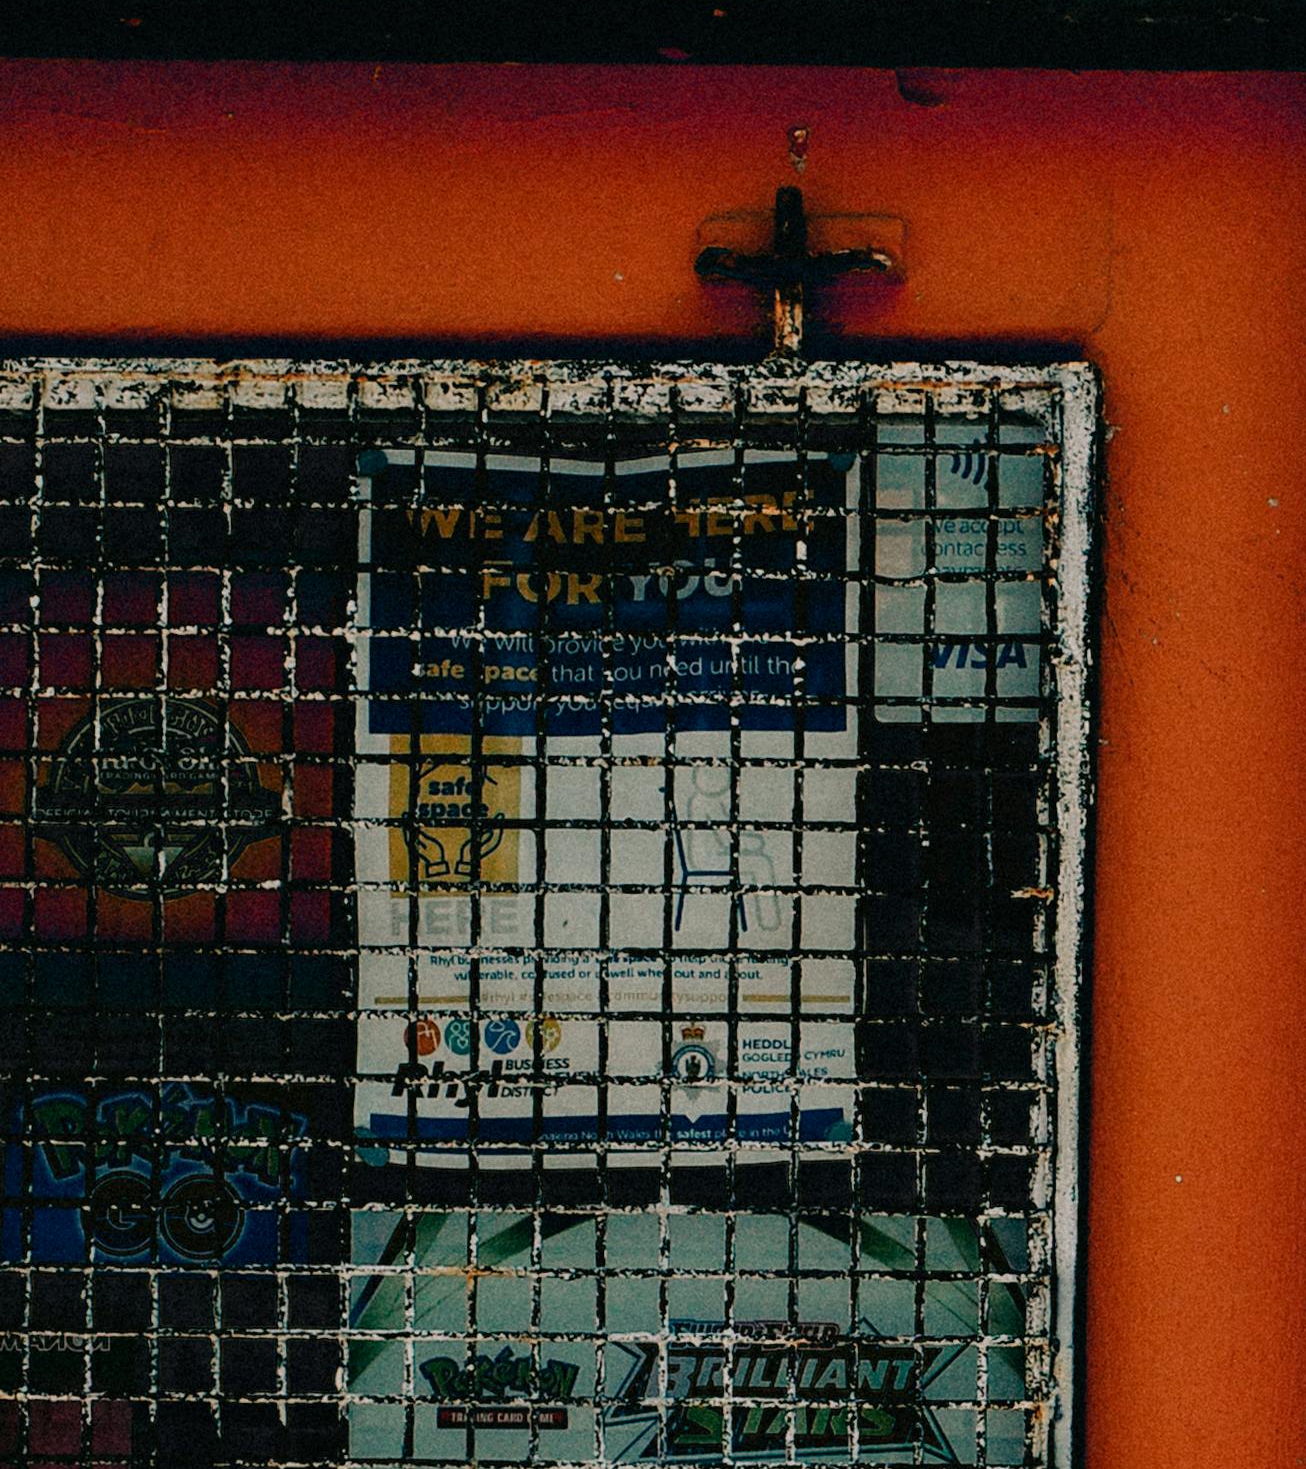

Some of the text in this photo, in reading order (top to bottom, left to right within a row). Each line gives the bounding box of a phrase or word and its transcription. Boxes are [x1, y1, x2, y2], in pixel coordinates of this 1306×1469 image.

[405, 489, 815, 545] WE ARE HERE
[959, 520, 1024, 536] accpt
[921, 541, 1027, 557] contacess
[482, 558, 743, 606] FOR YOU
[494, 631, 534, 653] will
[931, 640, 1027, 669] VISA
[412, 659, 465, 679] afe
[473, 663, 539, 684] pace
[551, 663, 594, 683] that
[602, 665, 642, 689] ou
[710, 654, 760, 675] until
[428, 777, 476, 797] safe
[37, 808, 273, 819] OFFICIA TOURAMENT TORE
[417, 802, 489, 827] space
[457, 955, 520, 965] bunesses
[454, 967, 763, 981] vulerable, cofused or uwell whe out and aout.
[742, 1039, 799, 1050] HEDDL
[742, 1048, 846, 1063] GOGLED CYMRU
[505, 1058, 570, 1070] BUSESS
[787, 1067, 829, 1080] ALES
[391, 1060, 503, 1107] Rhyl
[501, 1086, 558, 1098] DISTCT
[581, 1130, 614, 1141] Noh
[676, 1127, 712, 1140] safest
[714, 1128, 745, 1143] ple
[644, 1354, 914, 1399] BRILLIANT
[450, 1412, 495, 1423] TRAING
[527, 1412, 555, 1423] ME
[672, 1398, 898, 1445] STARS
